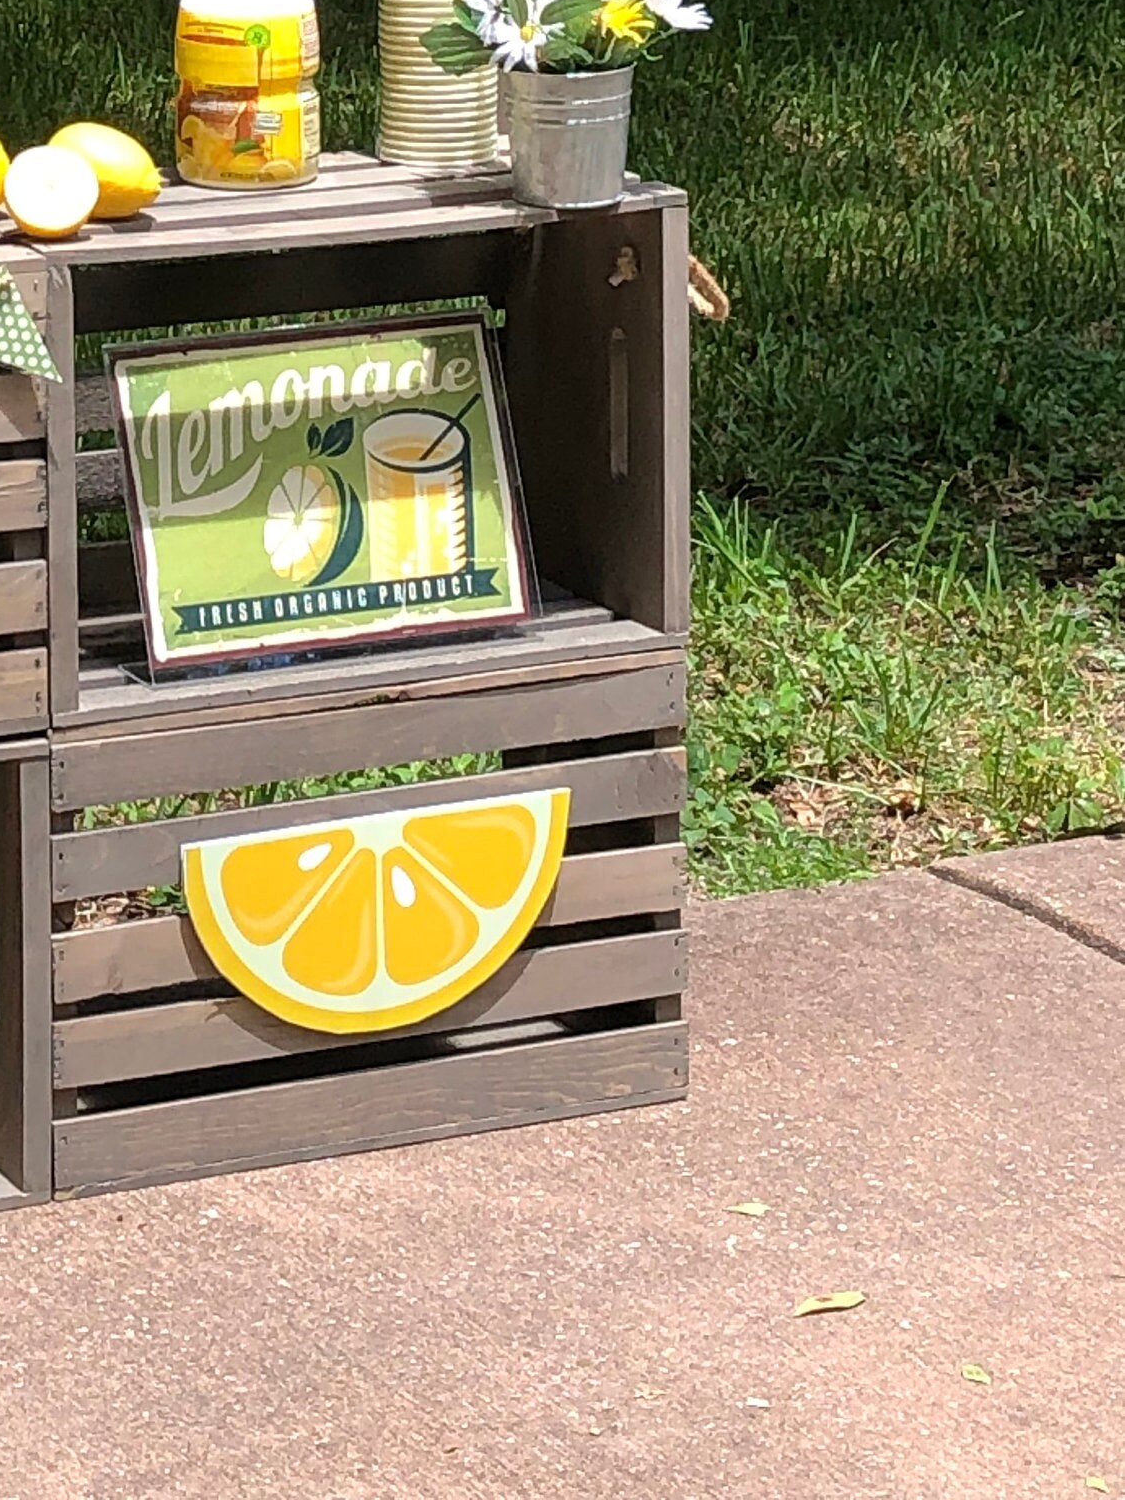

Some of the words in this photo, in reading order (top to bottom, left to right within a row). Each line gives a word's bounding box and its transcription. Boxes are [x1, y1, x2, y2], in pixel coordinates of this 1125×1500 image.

[141, 347, 476, 521] Lemonade
[199, 598, 263, 628] FRESH
[275, 587, 368, 618] ORGANIC
[379, 574, 475, 606] PRODUCT
